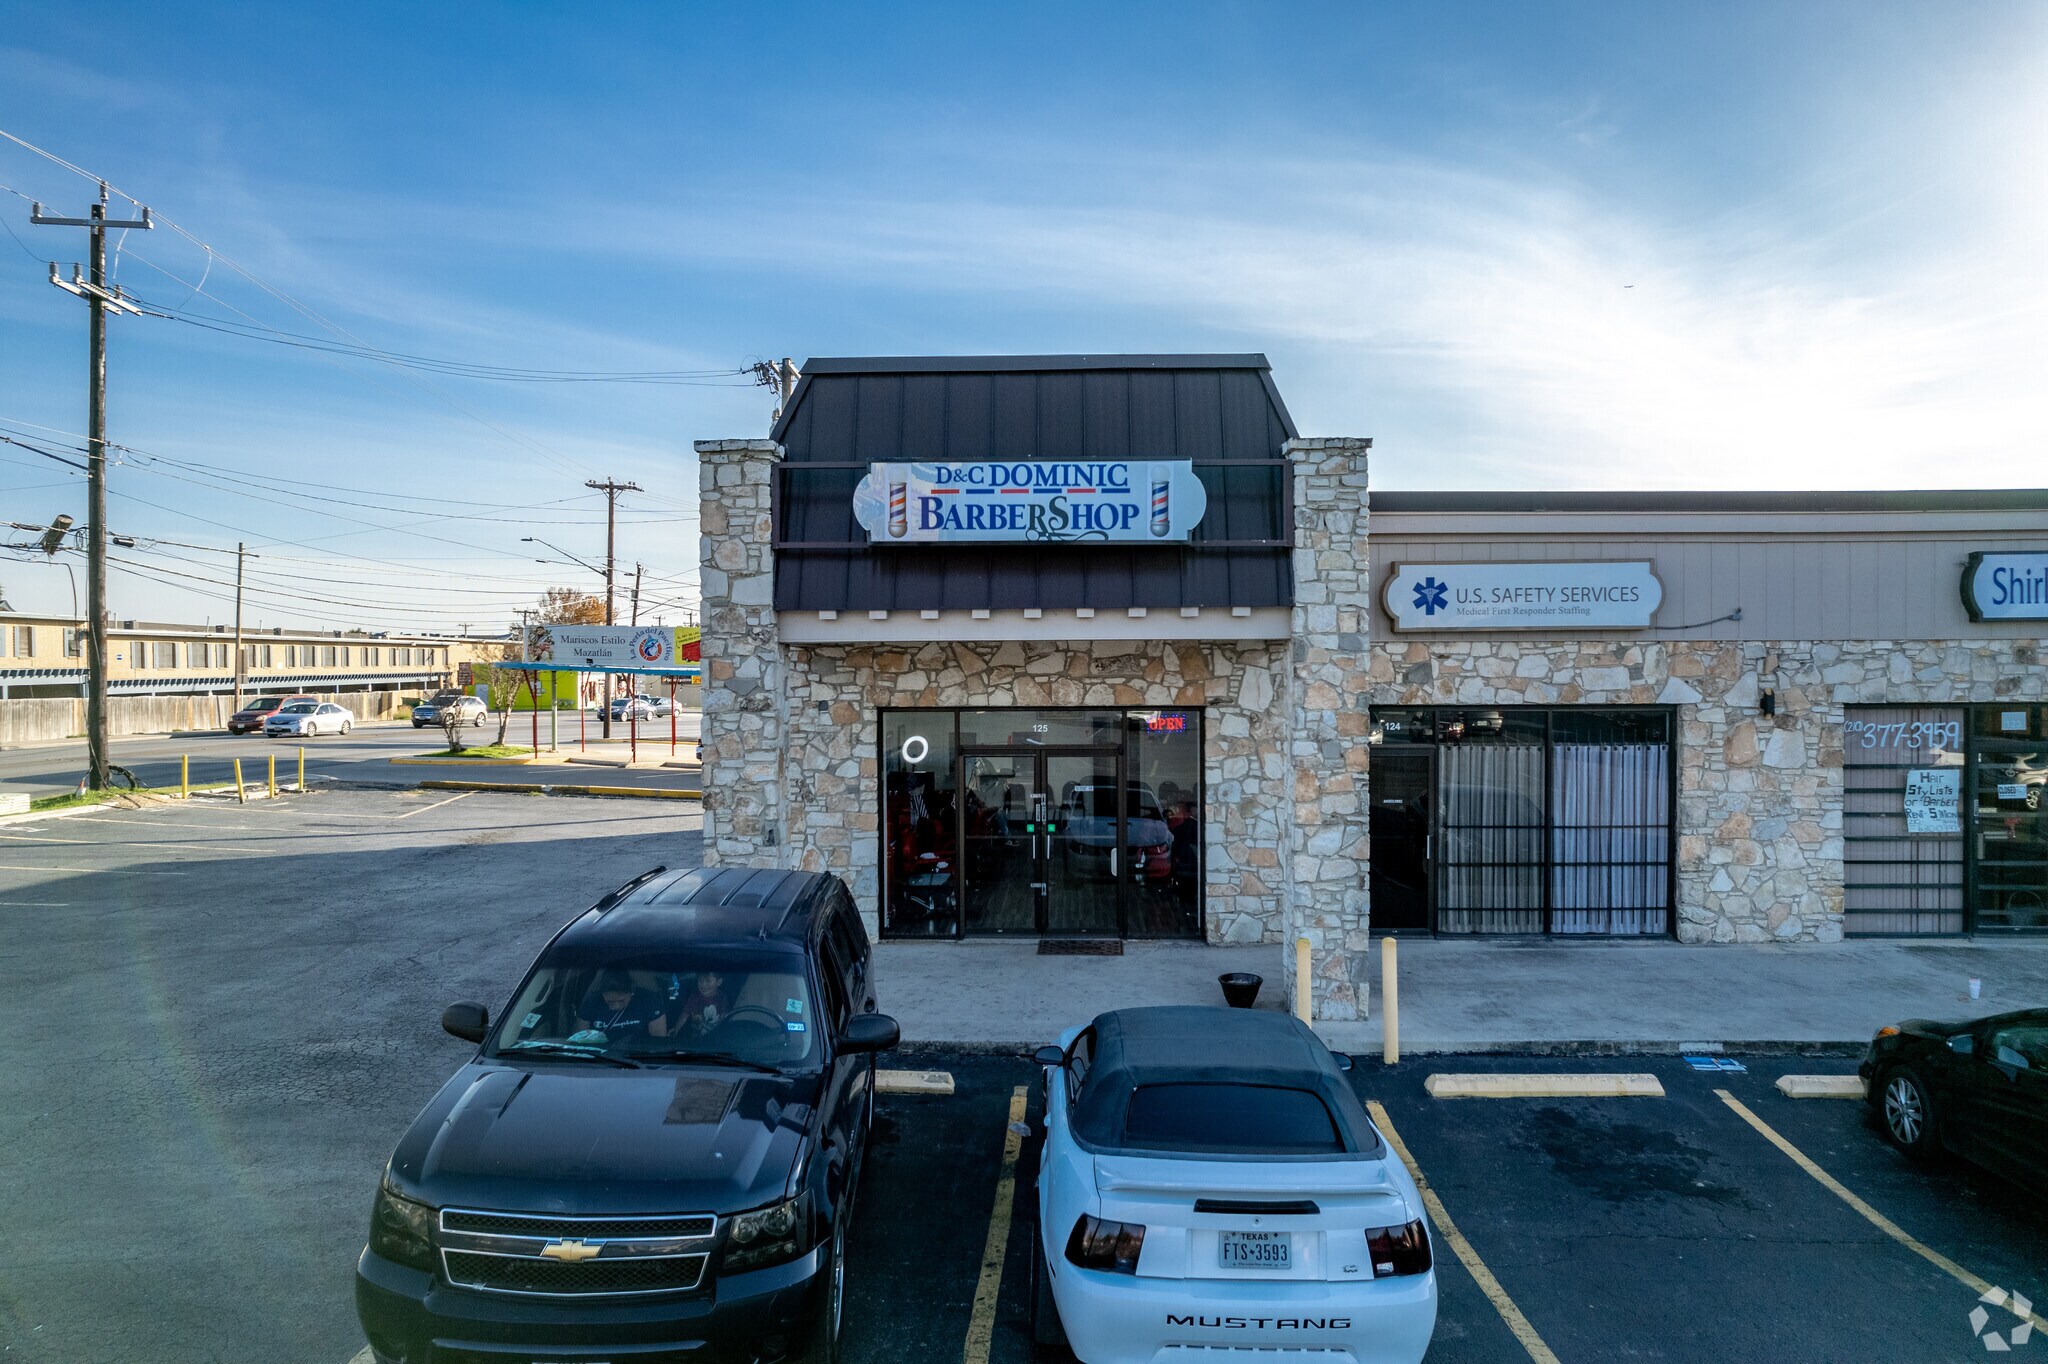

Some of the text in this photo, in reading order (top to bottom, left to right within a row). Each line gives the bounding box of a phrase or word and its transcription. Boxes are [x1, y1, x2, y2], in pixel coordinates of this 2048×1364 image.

[935, 464, 1128, 487] D&C DOMINIC
[917, 496, 1140, 532] BARBERSHOP
[1456, 586, 1639, 604] U.S. SAFETY SERVICES
[1456, 606, 1590, 617] Medical First Responder Staffing
[560, 635, 626, 645] Mariscos Estilo
[629, 630, 645, 647] Perla
[645, 627, 658, 635] del
[573, 648, 613, 657] Mazatlán
[1032, 724, 1048, 732] 125
[1149, 717, 1183, 730] OPEN
[1384, 722, 1401, 731] 124
[1861, 721, 1960, 749] 377-3959
[1166, 1315, 1351, 1329] MUSTANG
